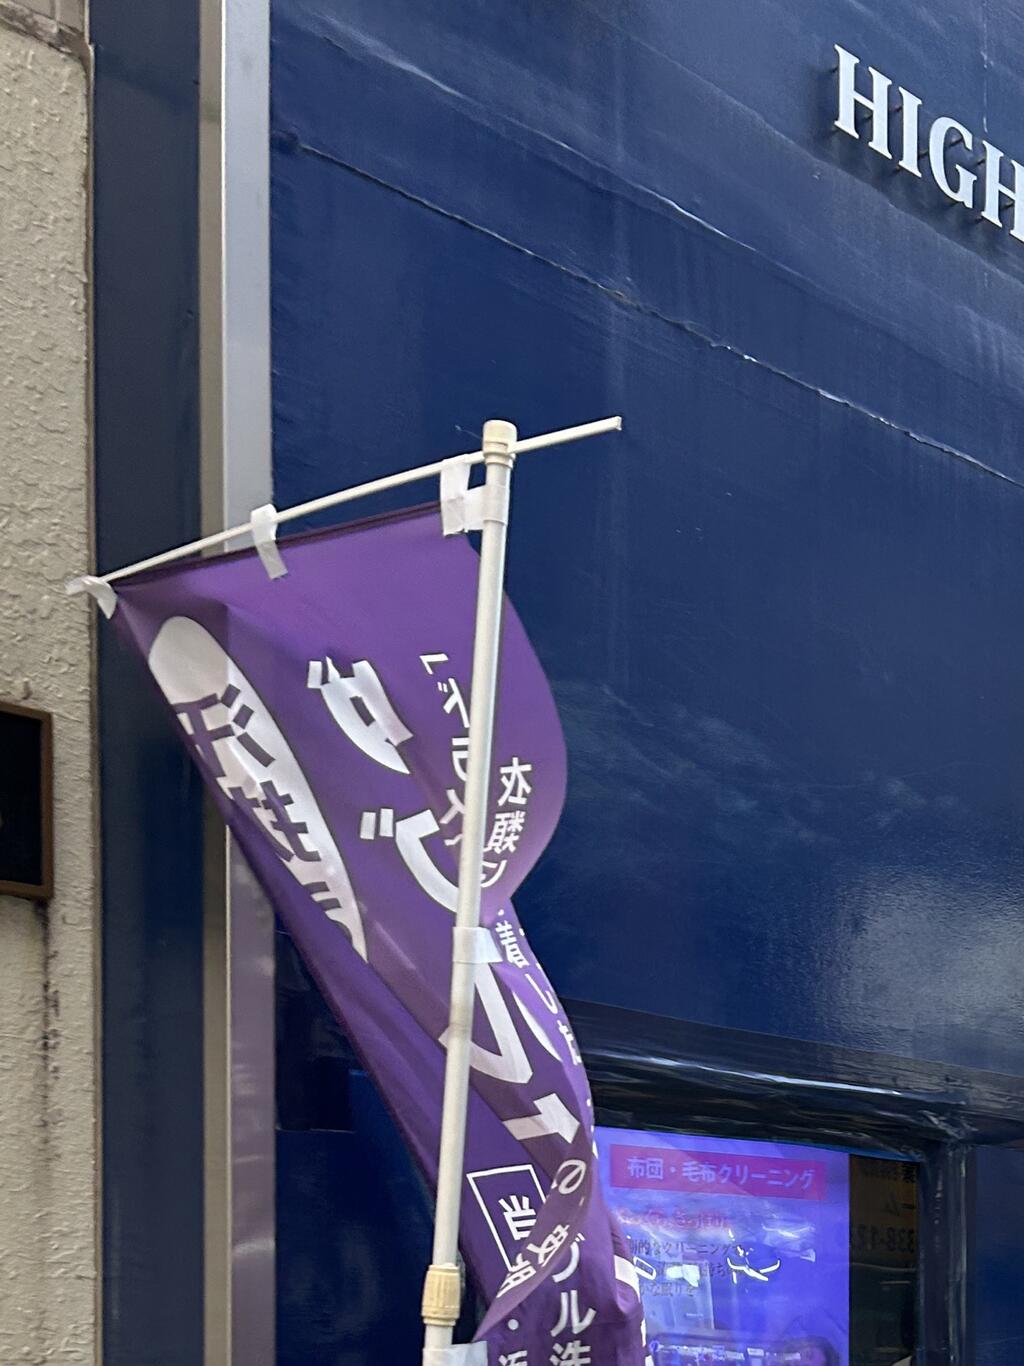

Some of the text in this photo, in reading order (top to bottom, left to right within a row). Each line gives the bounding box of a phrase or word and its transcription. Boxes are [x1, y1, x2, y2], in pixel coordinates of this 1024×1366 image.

[627, 1157, 815, 1189] 布団・毛布クリーニング
